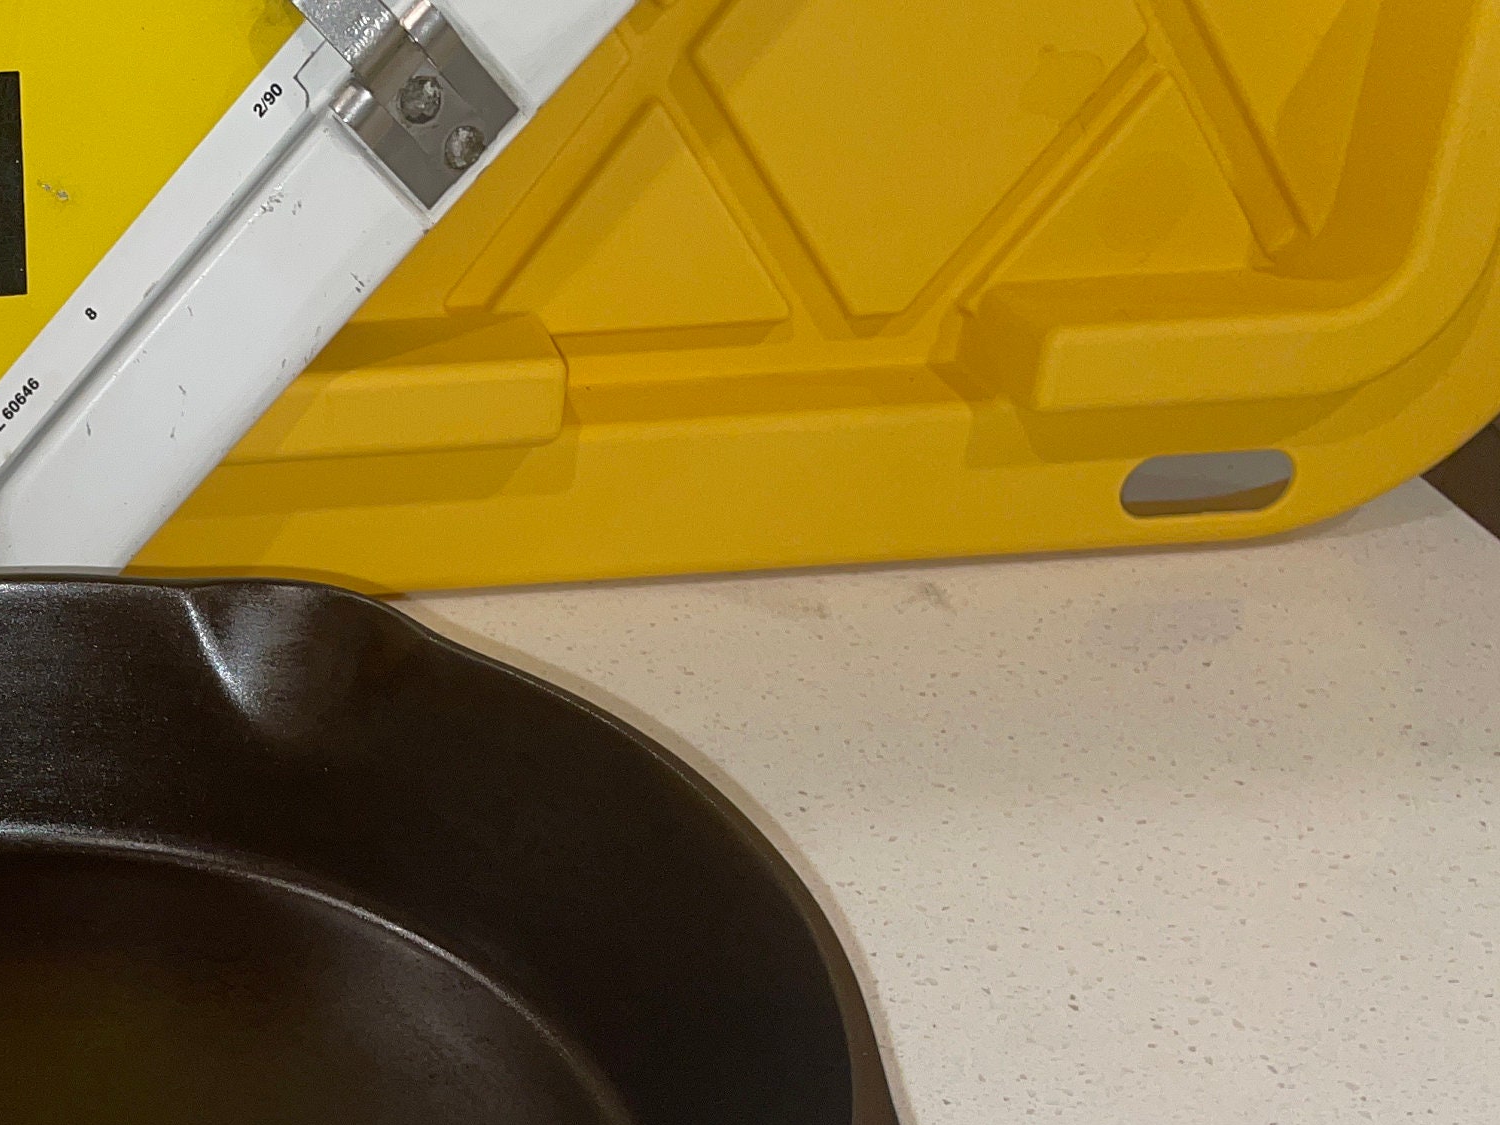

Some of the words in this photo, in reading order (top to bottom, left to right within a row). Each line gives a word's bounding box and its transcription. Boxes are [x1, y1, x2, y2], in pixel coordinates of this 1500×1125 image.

[253, 83, 283, 118] 2/90
[84, 307, 97, 321] 8
[2, 377, 40, 420] 60646
